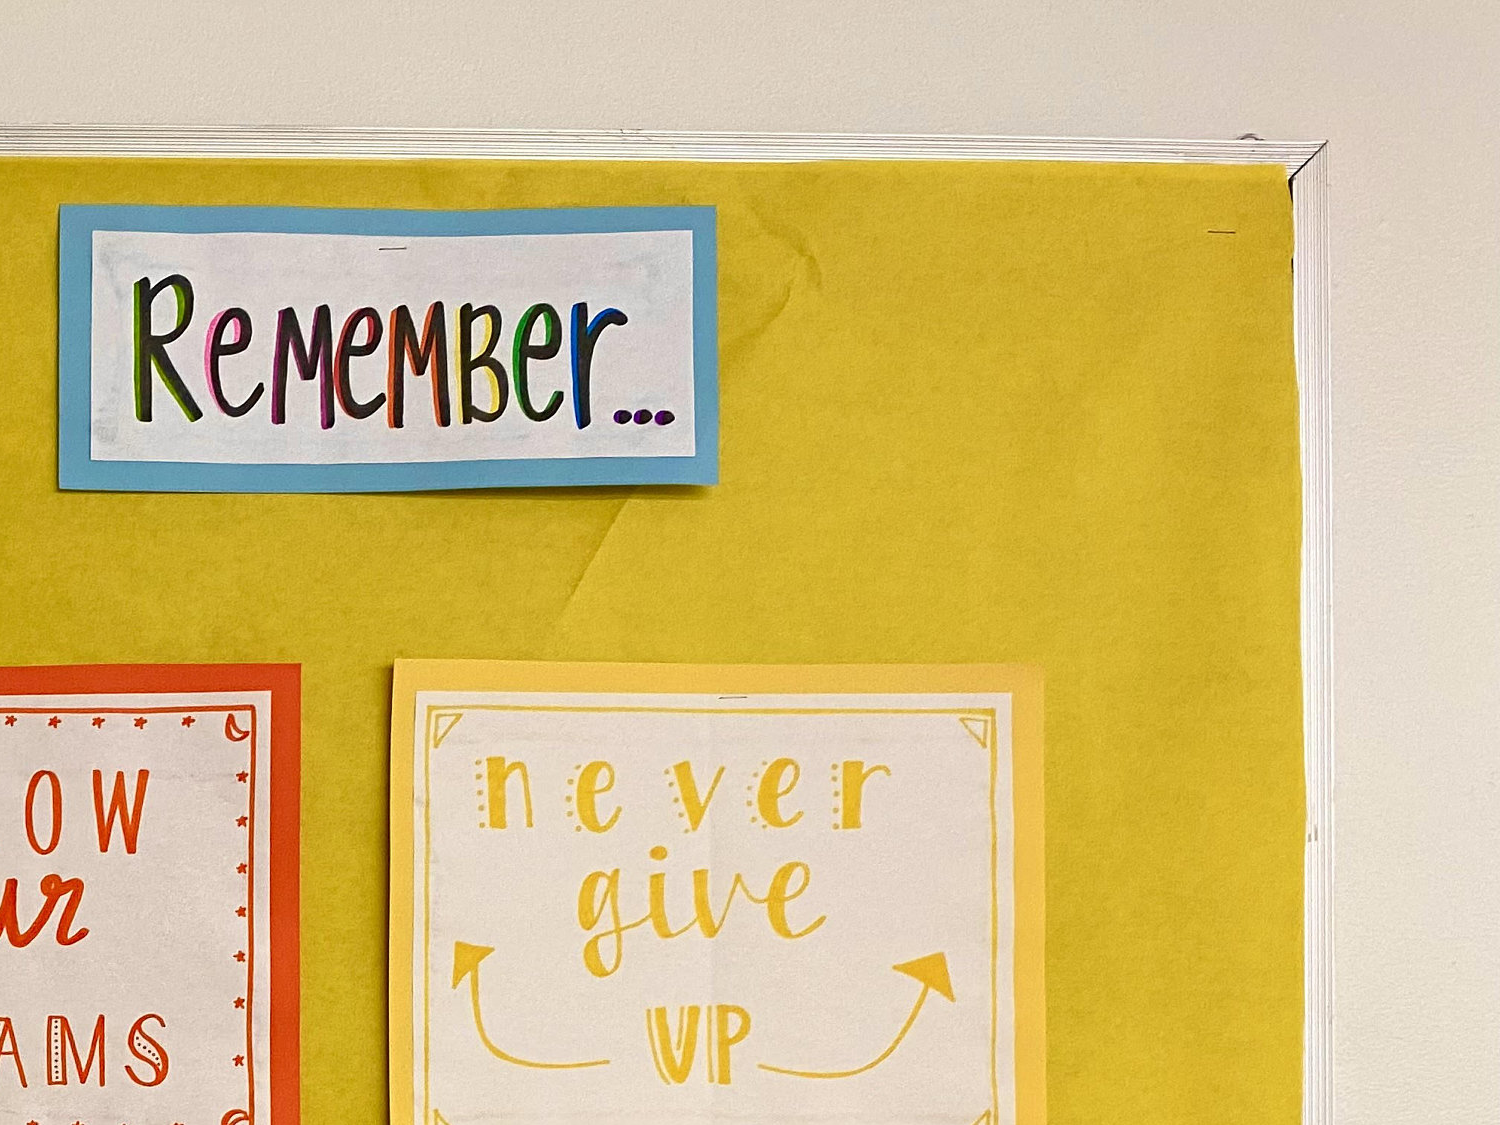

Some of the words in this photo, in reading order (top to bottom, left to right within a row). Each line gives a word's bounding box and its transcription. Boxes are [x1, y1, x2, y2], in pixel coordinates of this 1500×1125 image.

[482, 756, 890, 833] never
[578, 846, 826, 978] give
[647, 1005, 750, 1084] UP
